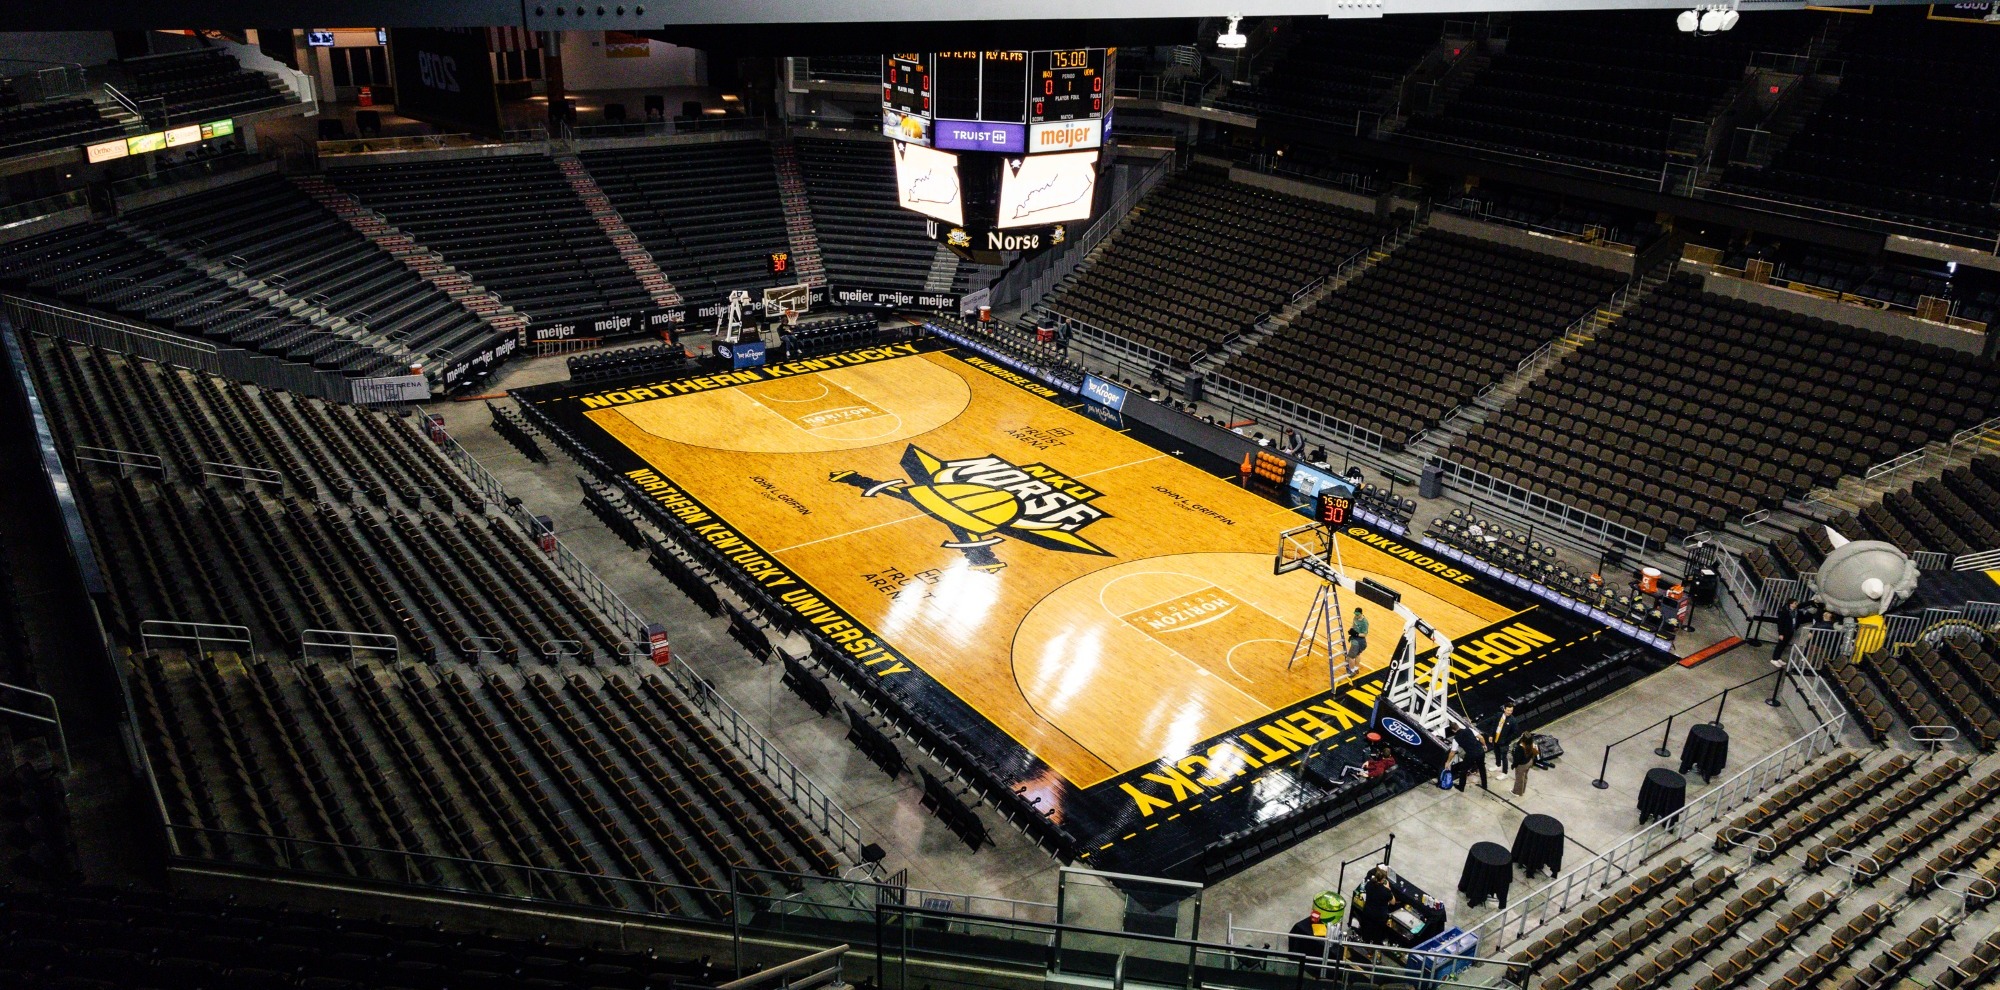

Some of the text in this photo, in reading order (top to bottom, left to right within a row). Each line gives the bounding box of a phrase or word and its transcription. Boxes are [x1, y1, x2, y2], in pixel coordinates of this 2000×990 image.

[986, 51, 1023, 61] PLY FL PTS
[1054, 51, 1086, 67] 75:00
[923, 75, 929, 90] 0
[1045, 80, 1053, 95] 0
[1093, 77, 1101, 92] 0
[1036, 102, 1043, 114] 0
[1093, 99, 1100, 110] 0
[953, 131, 991, 141] TRUIST
[1041, 123, 1090, 148] meijer
[987, 231, 1040, 251] Norse
[774, 261, 785, 271] 30
[792, 291, 823, 306] mejer
[839, 289, 873, 302] meijer
[919, 294, 954, 309] meijer
[595, 316, 632, 332] meijer
[651, 309, 686, 325] meijer
[537, 324, 576, 340] meijer
[447, 362, 469, 383] meijer
[496, 338, 516, 357] meijer
[745, 349, 764, 361] Kroger
[580, 369, 764, 410] NORTHERN
[762, 343, 920, 378] KENTUCKY
[965, 356, 1058, 398] NKUNORSE.COM
[1096, 383, 1120, 405] Kroger
[803, 407, 872, 424] HORIZON
[1004, 430, 1049, 451] ARENA
[1020, 426, 1066, 447] TRUIST
[1022, 464, 1096, 500] NKU
[749, 476, 776, 490] JOHN
[778, 494, 813, 516] GRIFFIN
[947, 457, 1102, 531] NORSE
[1322, 496, 1349, 509] 75:00
[1151, 485, 1184, 500] JOHN
[1192, 504, 1236, 526] GRIFFIN
[1324, 506, 1344, 523] 30
[1347, 527, 1475, 584] @NKUNORSE
[625, 469, 912, 677] NORTHERN KENTUCKY UNIVERSITY
[882, 566, 936, 599] TRUT
[860, 573, 902, 602] AREN
[1146, 598, 1231, 630] HORIZON
[1388, 721, 1414, 742] Ford
